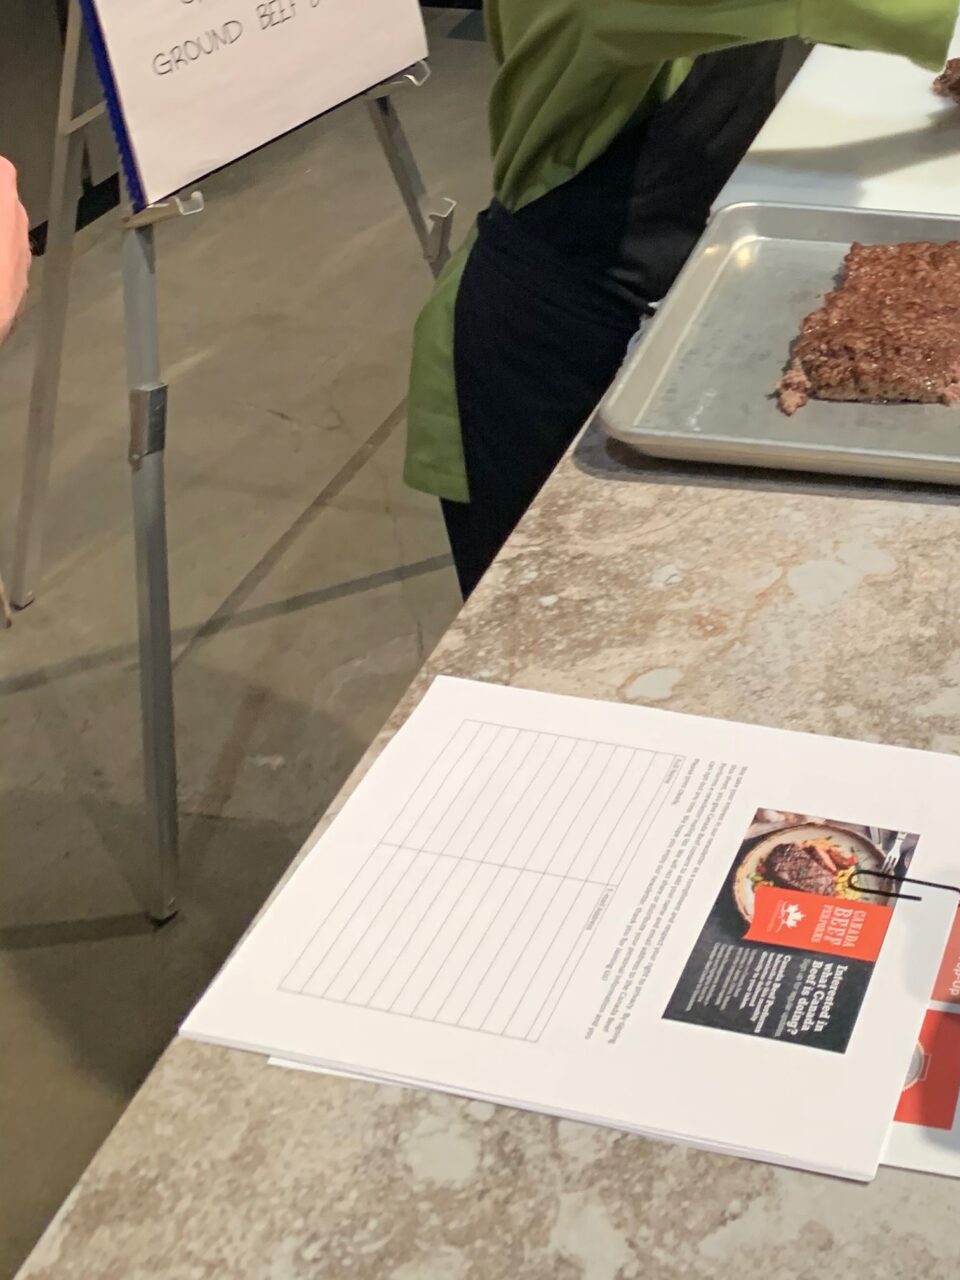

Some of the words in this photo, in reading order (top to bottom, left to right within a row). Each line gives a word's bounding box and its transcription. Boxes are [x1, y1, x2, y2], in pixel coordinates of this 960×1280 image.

[152, 20, 243, 77] GROUND
[824, 907, 852, 945] BEEF
[843, 910, 865, 946] CANADA
[800, 985, 813, 995] is
[805, 960, 823, 985] Beef
[817, 963, 833, 988] what
[819, 965, 847, 1018] Interested
[786, 997, 808, 1034] doing?
[801, 990, 824, 1030] Canada
[813, 1020, 827, 1031] in
